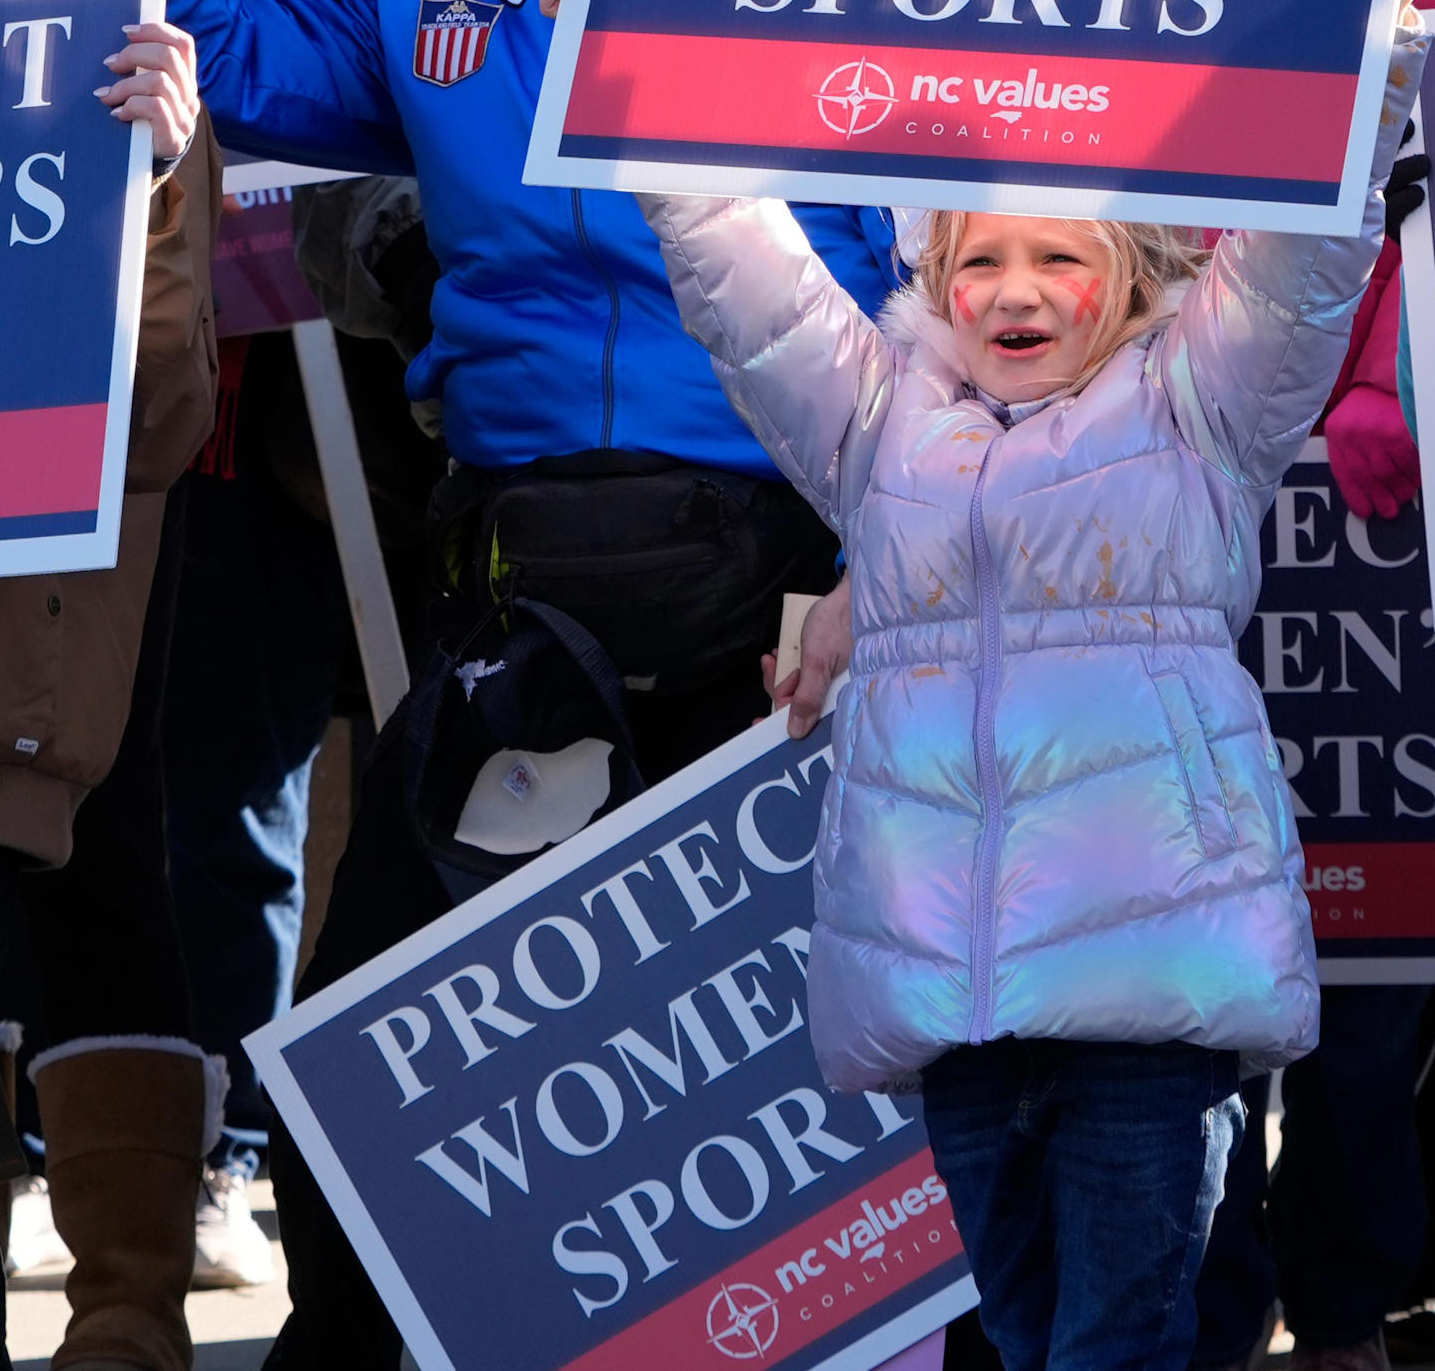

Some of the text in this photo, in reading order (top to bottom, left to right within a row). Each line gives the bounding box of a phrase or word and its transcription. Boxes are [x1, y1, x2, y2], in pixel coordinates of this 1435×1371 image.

[436, 13, 476, 22] KAPPA
[911, 68, 1110, 113] nc values
[906, 121, 1101, 145] COALITION
[415, 925, 812, 1219] WOME
[775, 1174, 948, 1294] nc values
[800, 1220, 957, 1320] COALITIO
